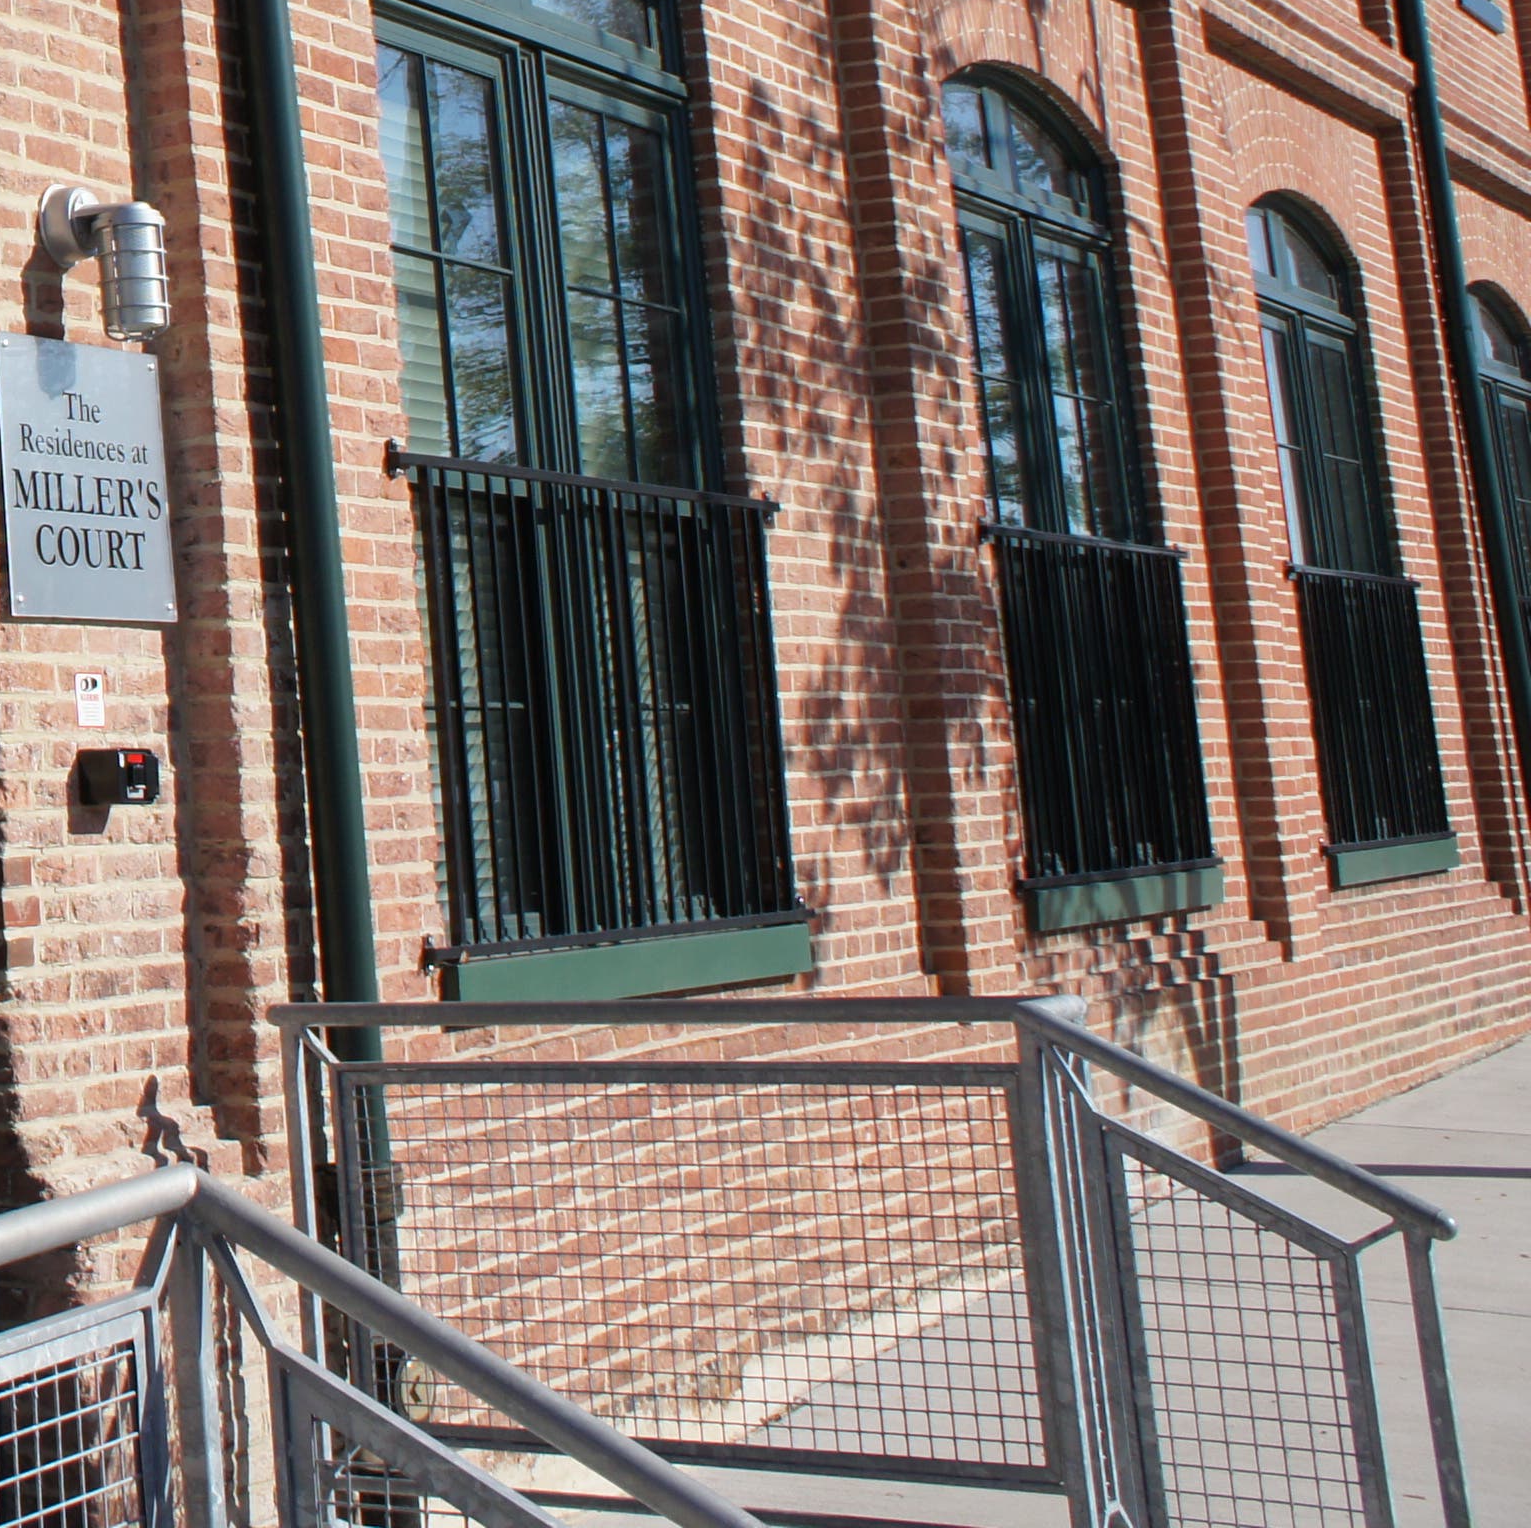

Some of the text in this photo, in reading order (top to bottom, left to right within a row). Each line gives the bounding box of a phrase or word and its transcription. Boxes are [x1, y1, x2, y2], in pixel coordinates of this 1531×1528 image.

[62, 392, 100, 423] The
[20, 423, 147, 464] Residences at
[13, 469, 161, 520] MILLER'S
[36, 524, 145, 570] COURT
